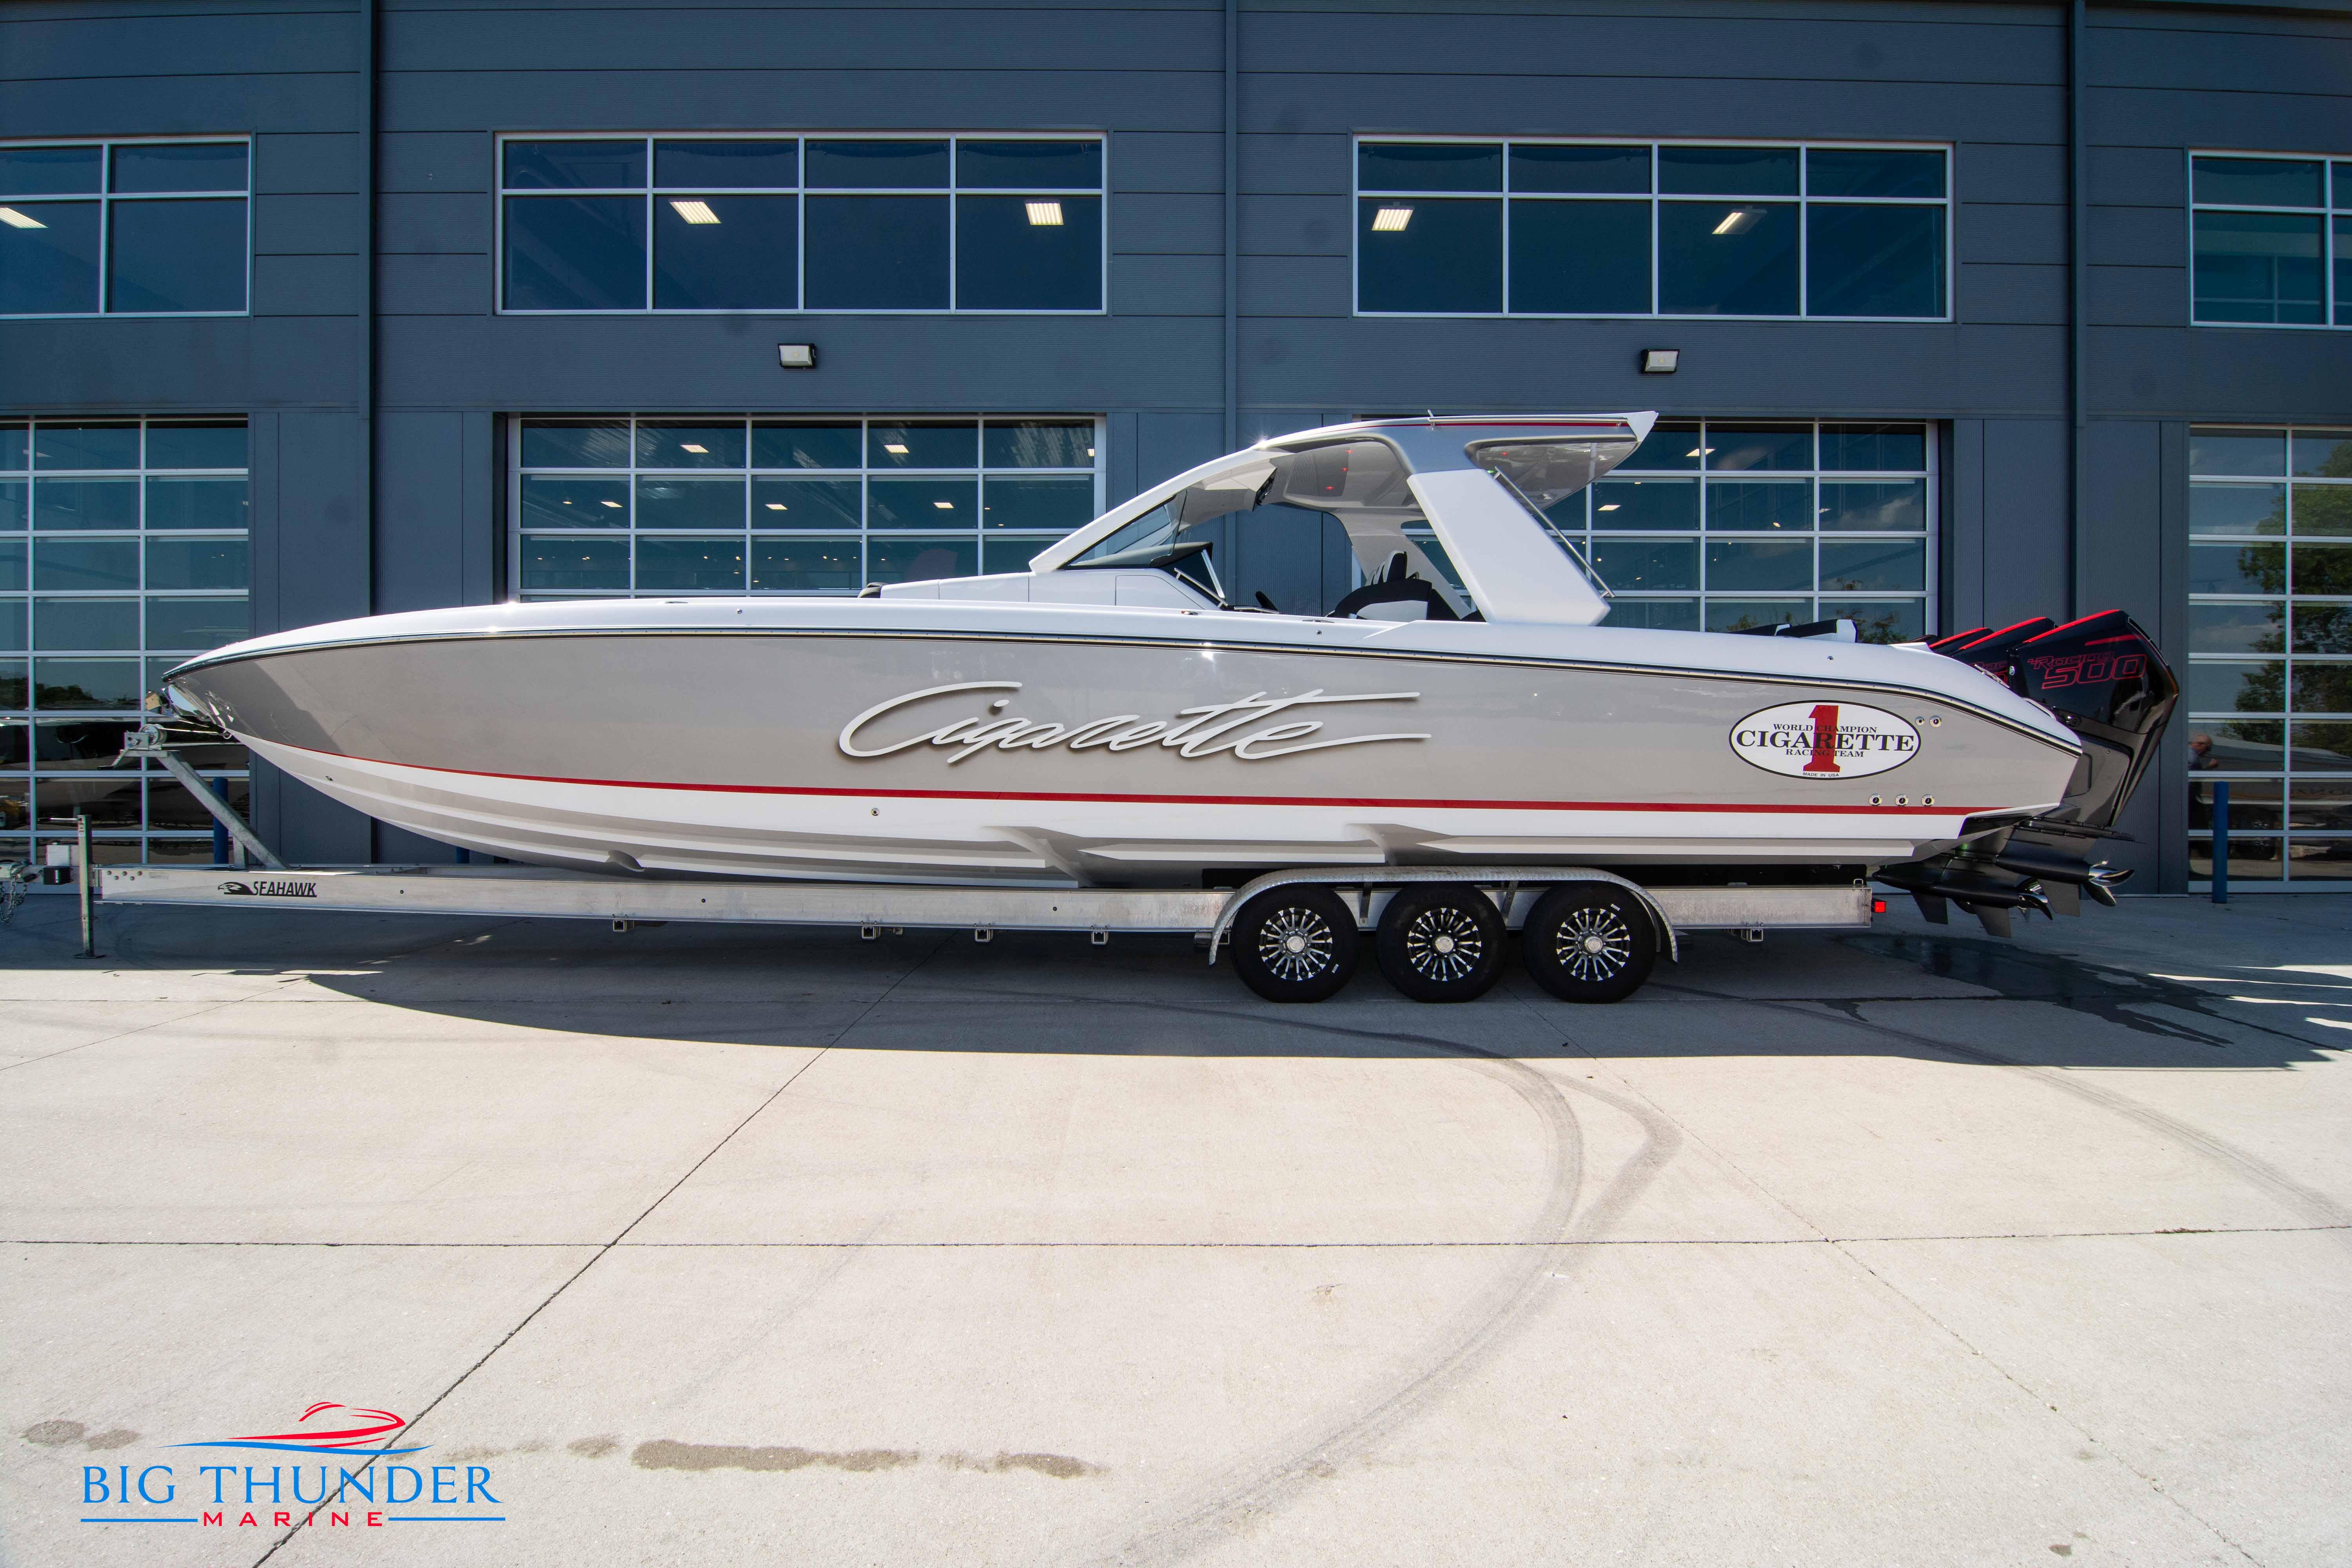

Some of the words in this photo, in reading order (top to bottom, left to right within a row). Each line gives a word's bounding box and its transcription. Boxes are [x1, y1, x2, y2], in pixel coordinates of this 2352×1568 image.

[2042, 654, 2147, 690] 500
[840, 681, 1432, 763] Cigarette
[1817, 725, 1877, 733] CHAMPION
[1737, 730, 1915, 751] CIGARETTE
[1803, 705, 1840, 773] 1
[253, 881, 318, 897] SEAHAWK
